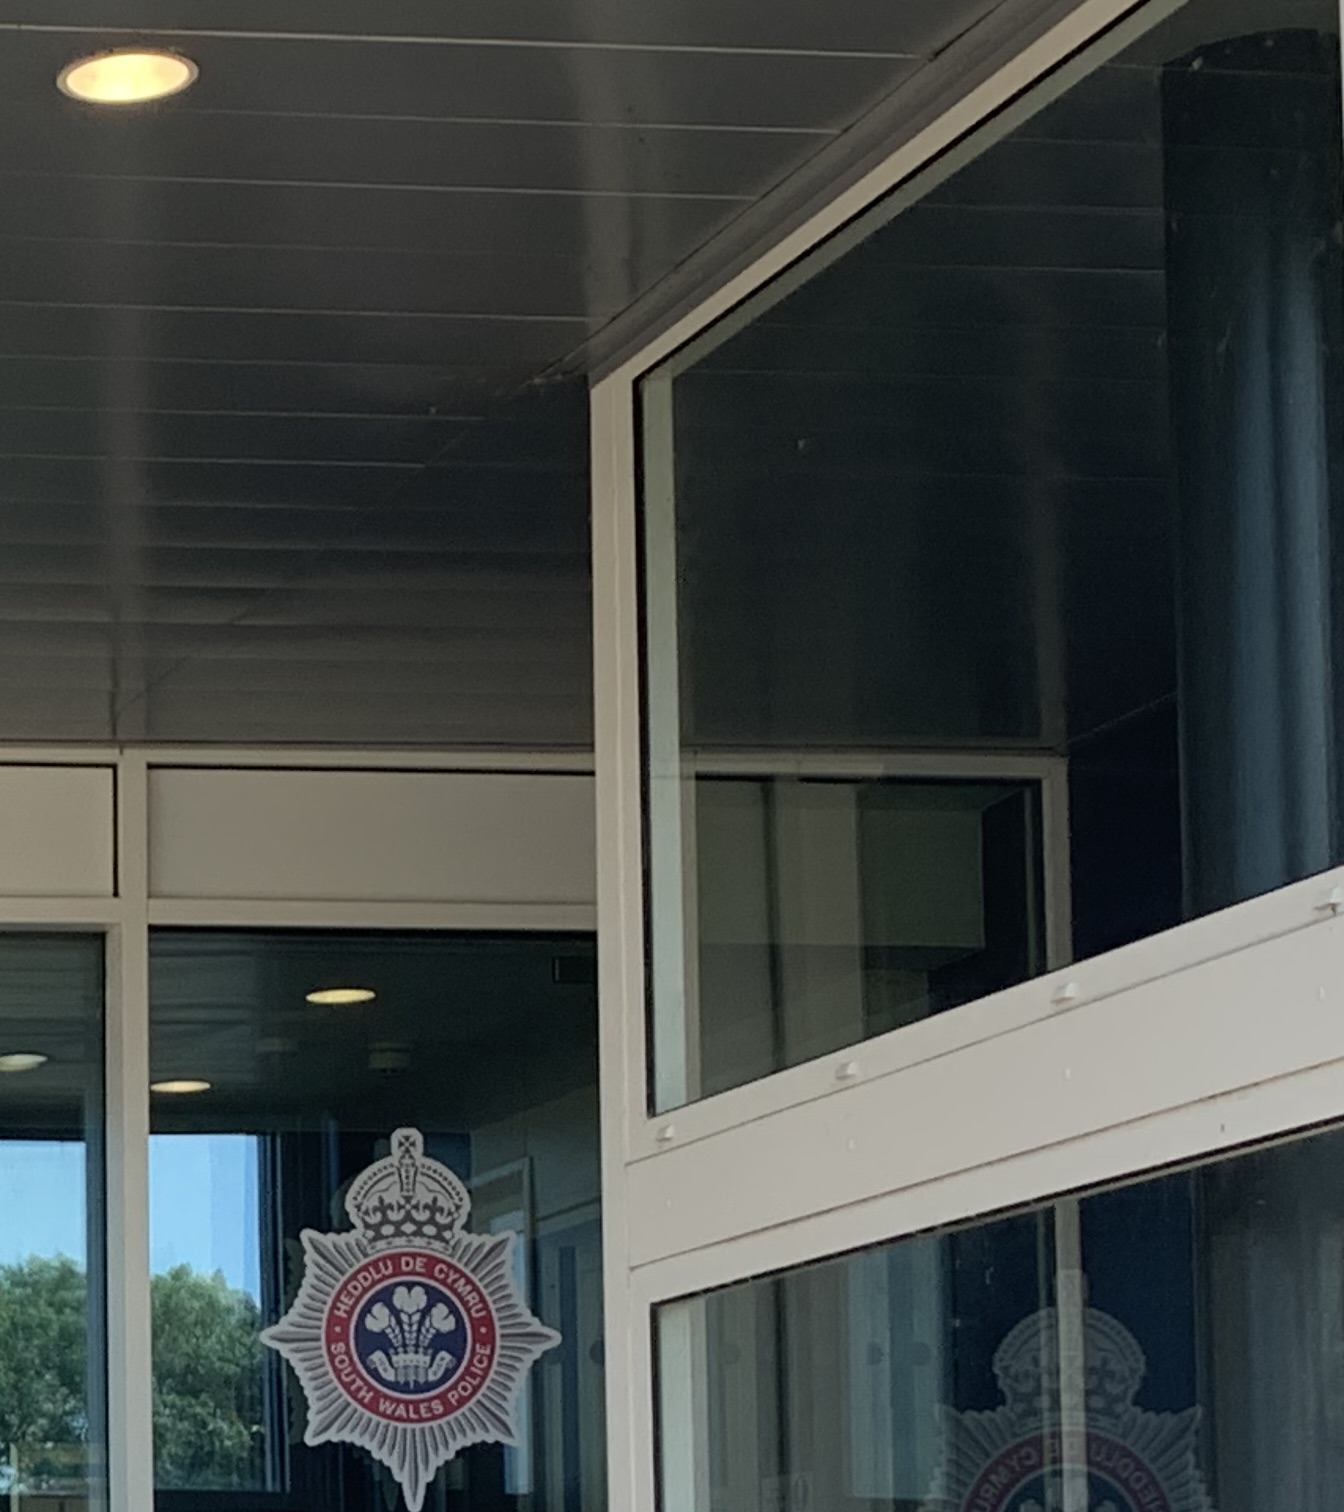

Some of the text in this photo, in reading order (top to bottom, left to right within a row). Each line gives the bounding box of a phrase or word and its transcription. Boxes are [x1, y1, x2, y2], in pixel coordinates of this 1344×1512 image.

[335, 1256, 488, 1319] HEDDLU DE CYMRU
[330, 1342, 492, 1418] SOUTH WALES POLICE
